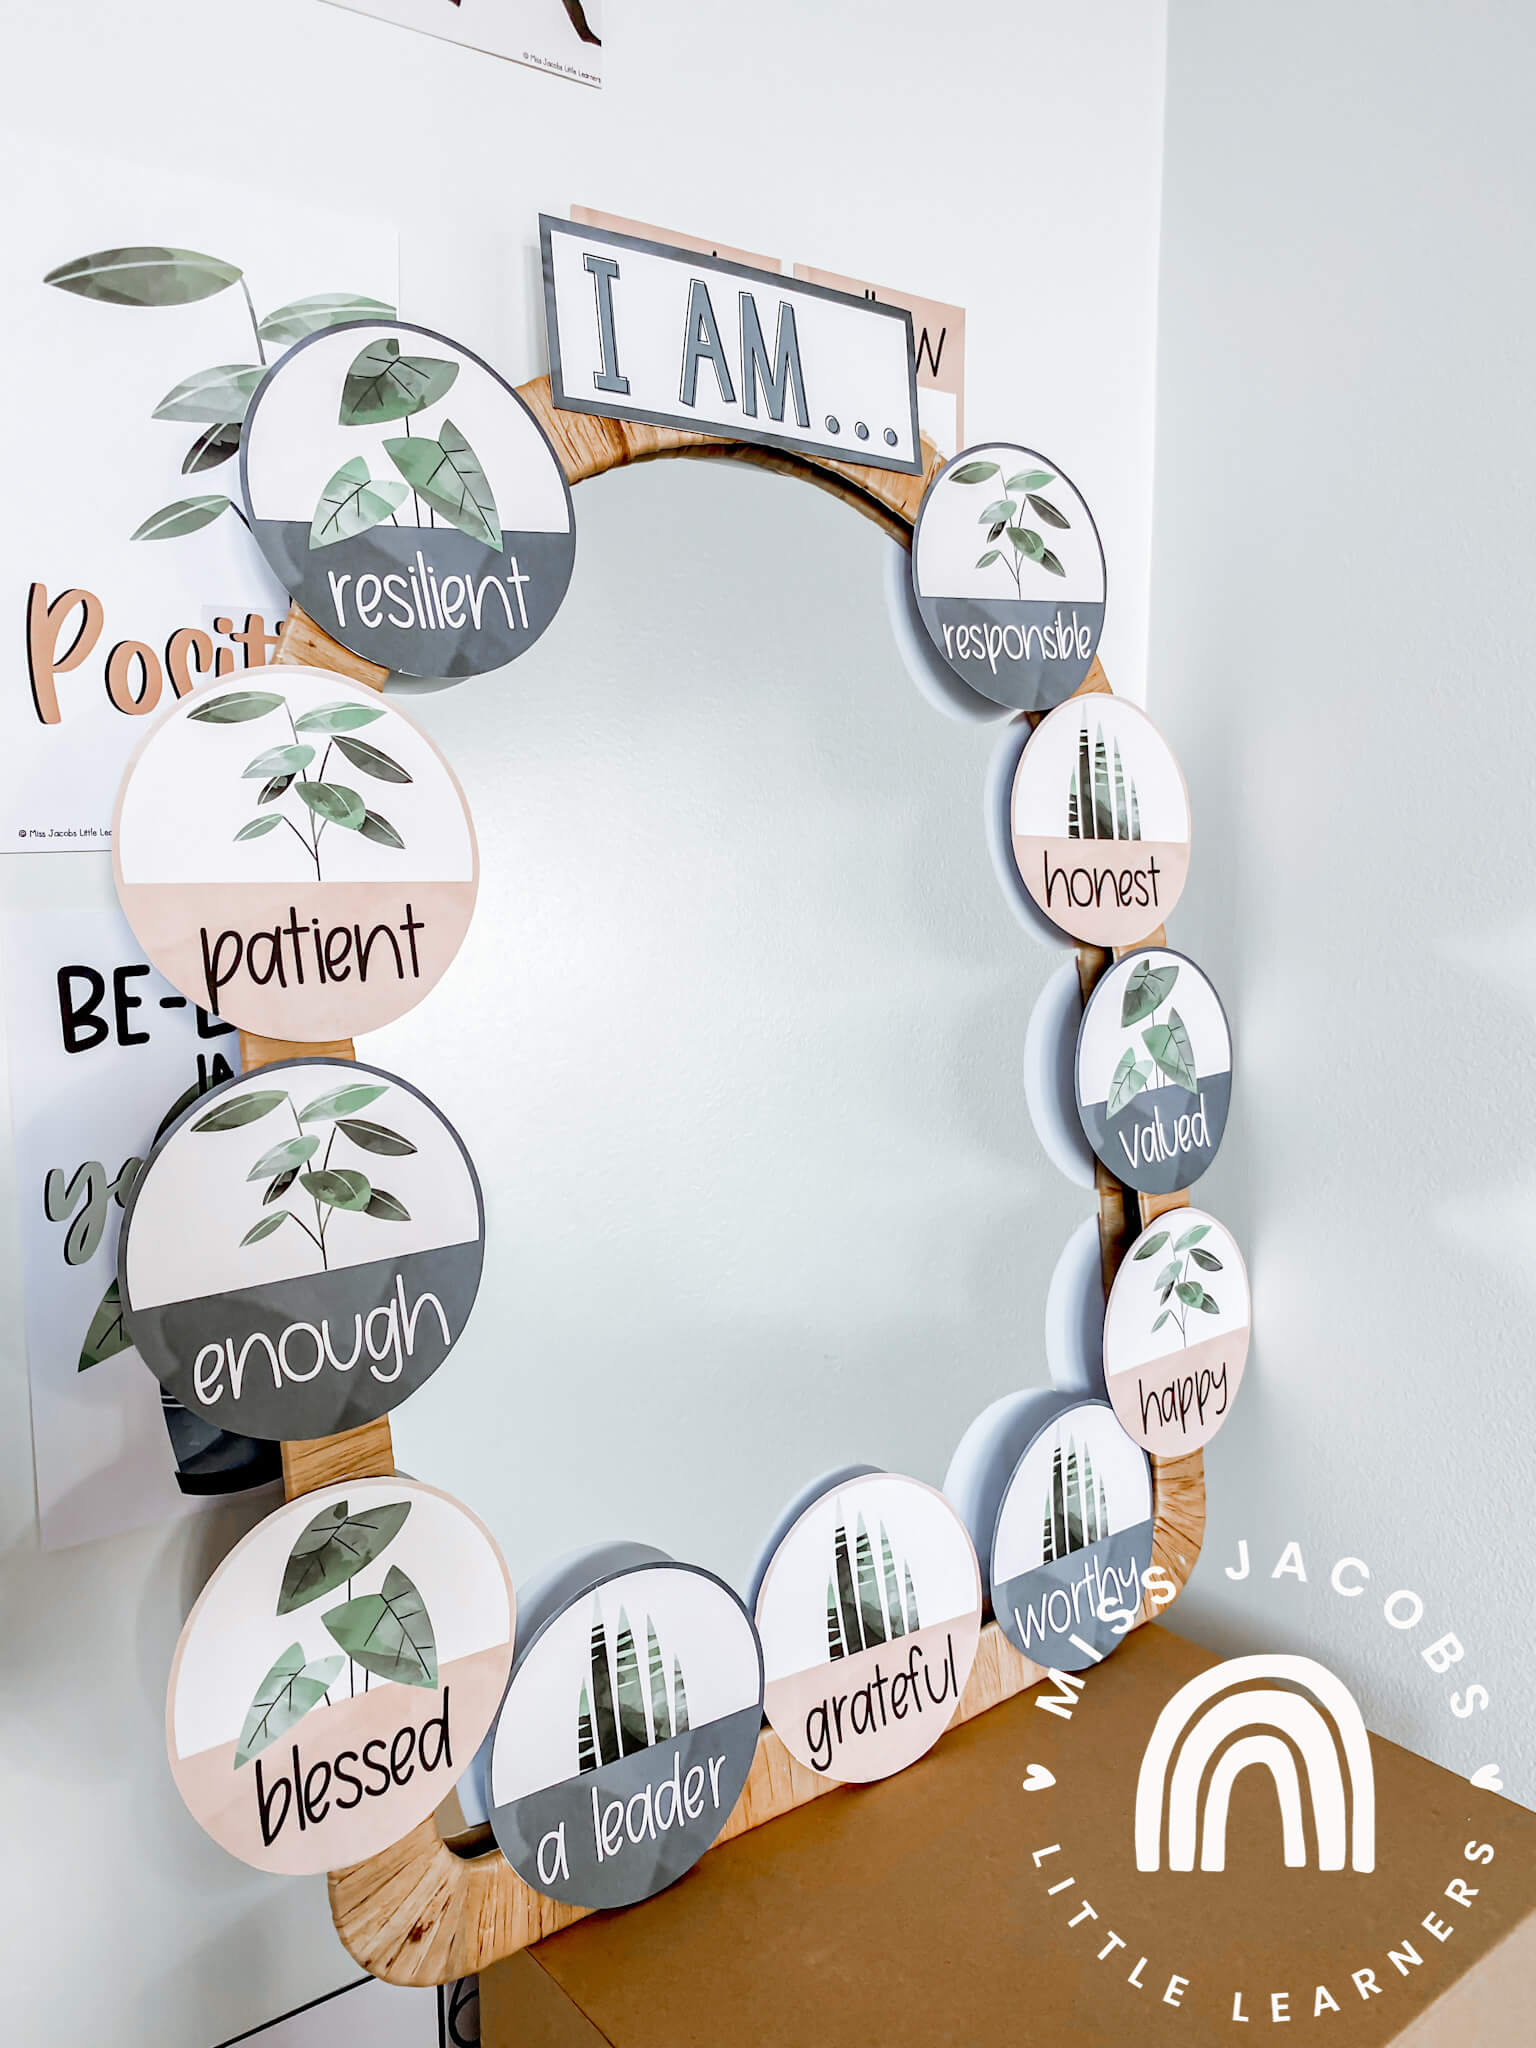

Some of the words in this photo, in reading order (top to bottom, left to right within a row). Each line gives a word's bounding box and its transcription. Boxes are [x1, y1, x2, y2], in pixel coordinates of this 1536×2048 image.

[583, 252, 630, 394] I
[327, 550, 531, 631] resilient
[941, 610, 1092, 675] responsible
[29, 829, 46, 838] Miss
[48, 829, 77, 838] Jacobs
[79, 827, 97, 837] Little
[1043, 849, 1161, 908] honest
[199, 903, 425, 1017] patient
[1118, 1092, 1212, 1169] valued
[193, 1273, 451, 1406] enough
[1138, 1361, 1229, 1435] happy
[1014, 1554, 1142, 1649] worthy
[805, 1634, 959, 1771] grateful
[255, 1686, 454, 1847] blessed
[536, 1821, 570, 1885] a
[591, 1750, 726, 1863] leader
